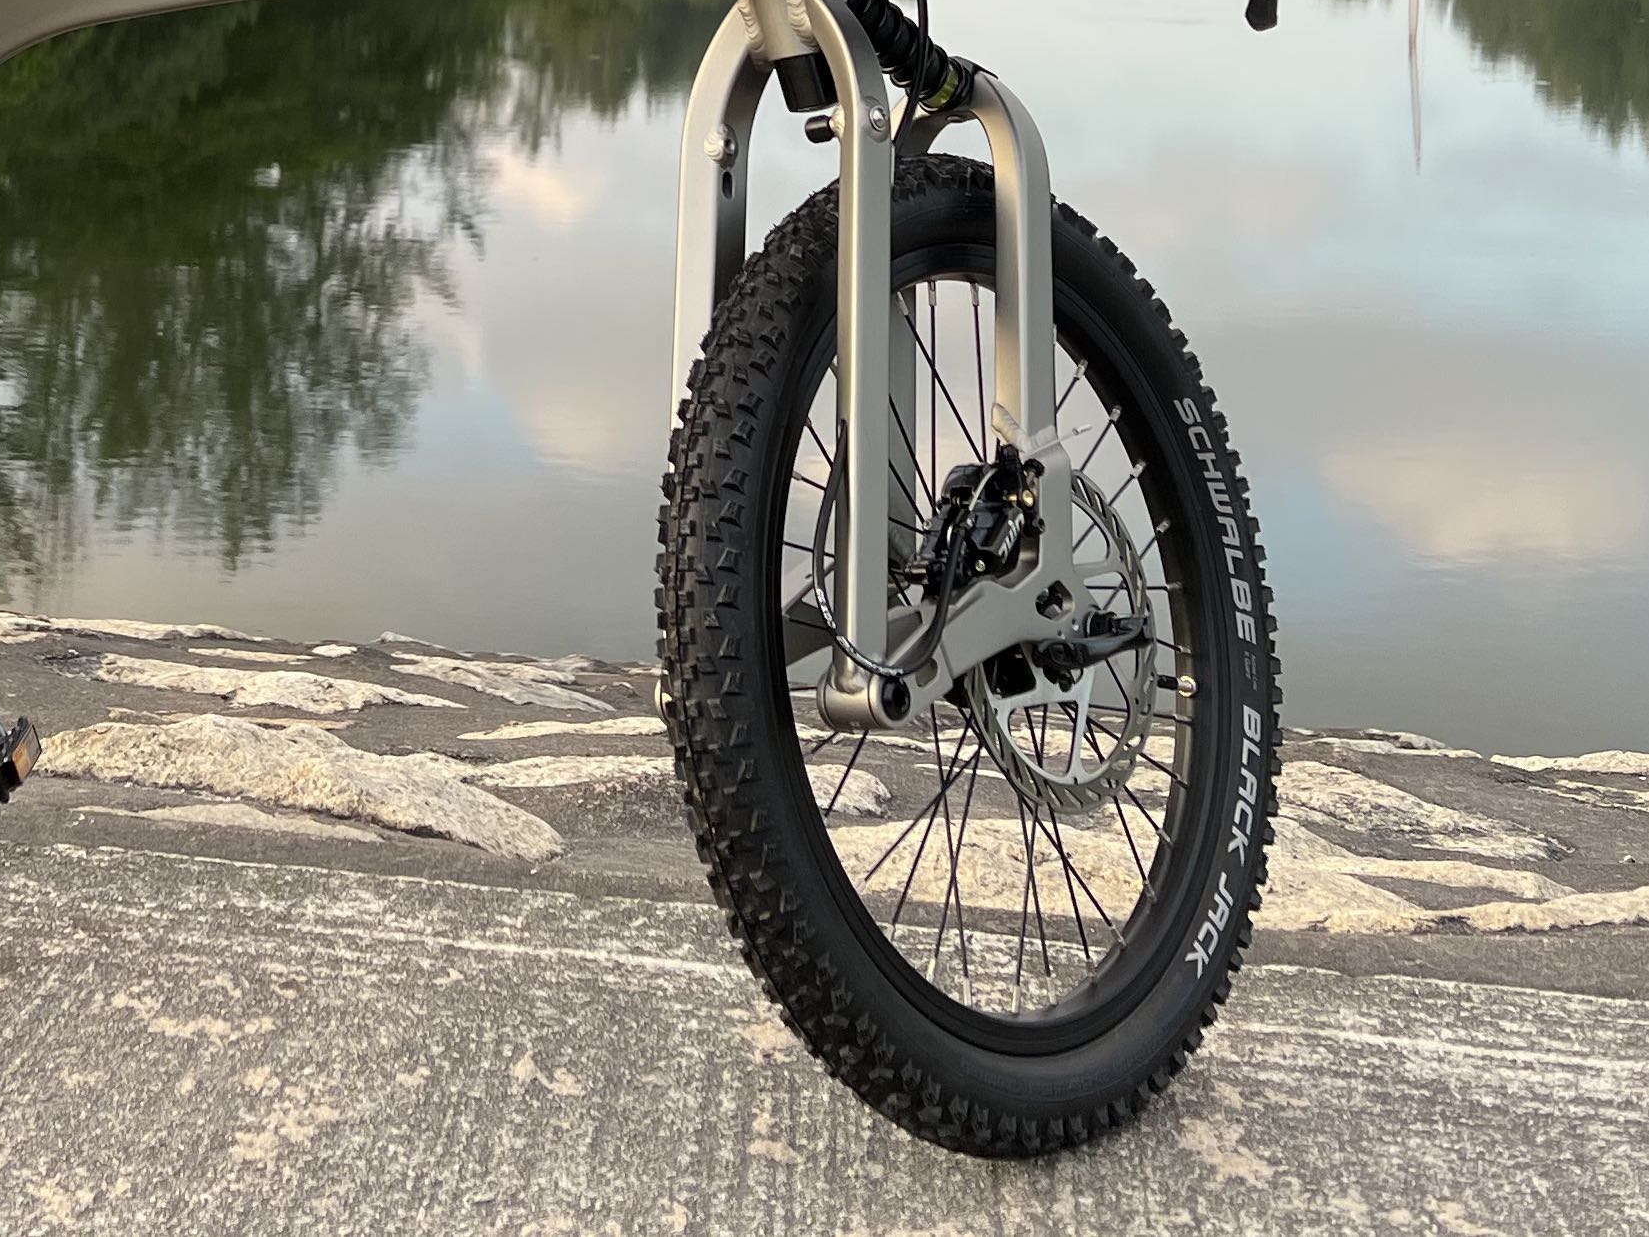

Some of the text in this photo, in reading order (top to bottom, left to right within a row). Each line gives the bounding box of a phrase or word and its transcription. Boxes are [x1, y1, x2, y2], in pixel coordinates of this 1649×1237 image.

[1173, 396, 1262, 980] SCHWALBE BLACK JACK
